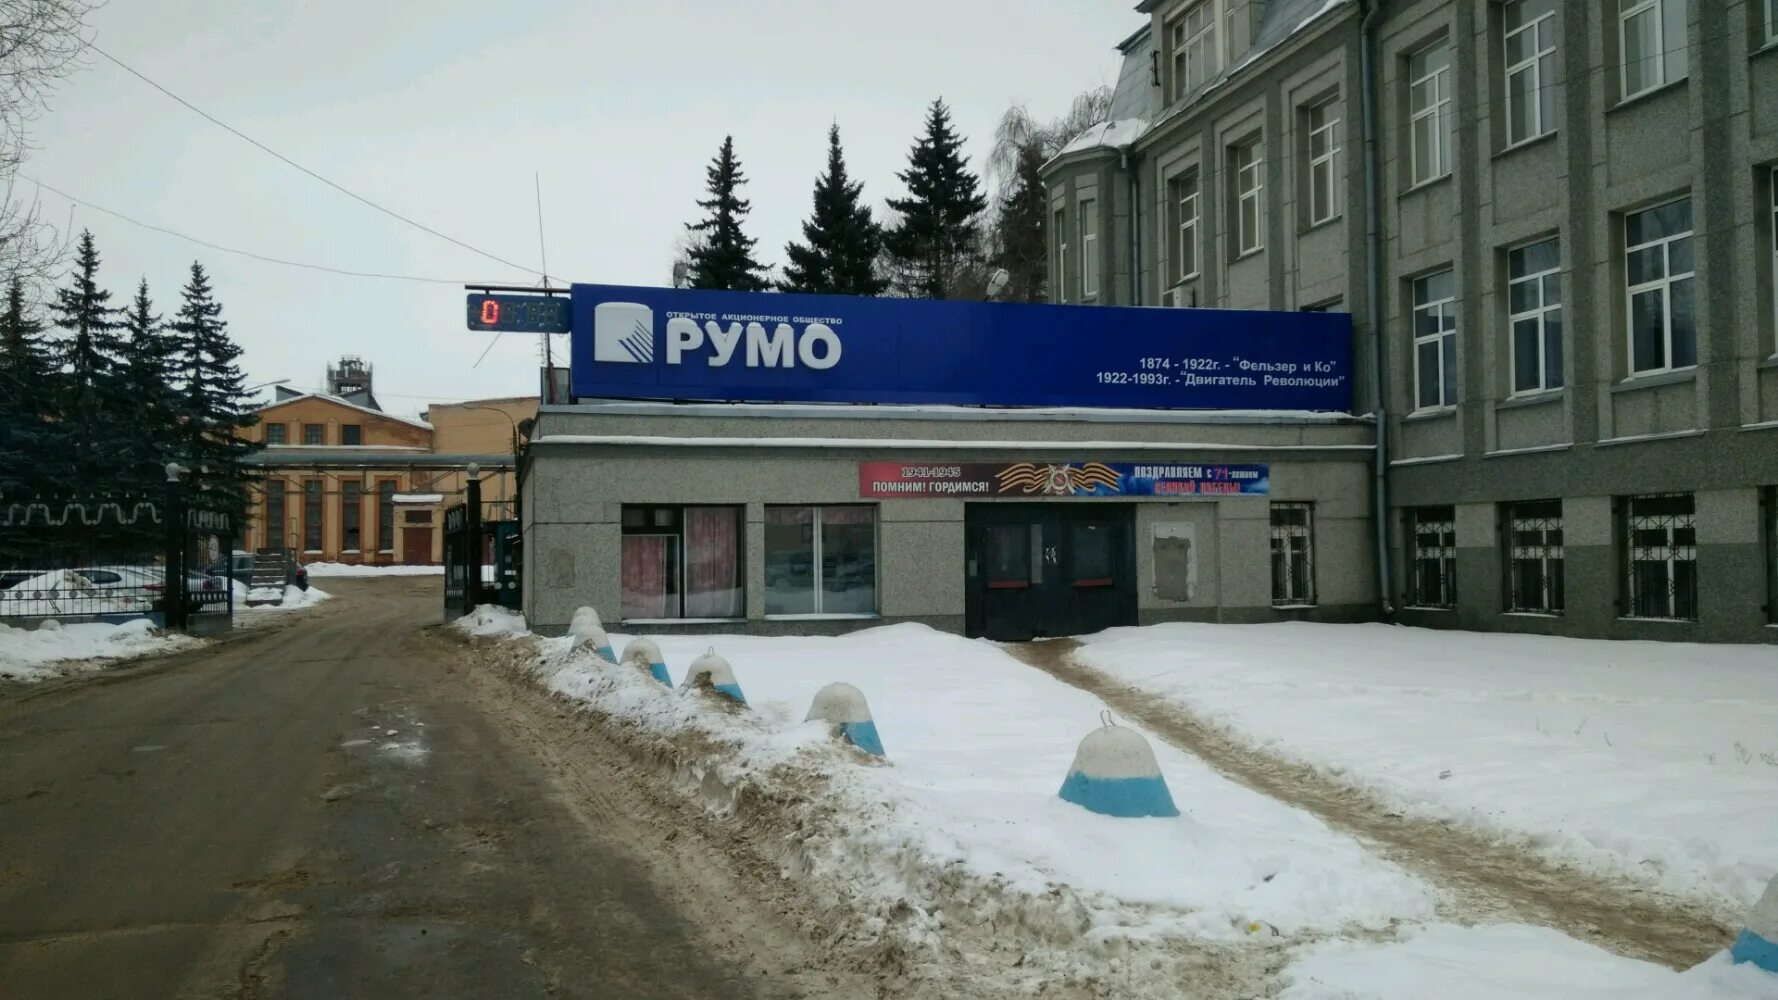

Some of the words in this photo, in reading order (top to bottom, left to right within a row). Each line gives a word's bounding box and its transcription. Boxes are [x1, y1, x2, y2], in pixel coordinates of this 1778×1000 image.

[481, 300, 498, 324] 0
[666, 311, 717, 320] ОТКРЫТОЕ
[722, 313, 789, 323] АКЦИОНЕРНОЕ
[793, 316, 843, 325] ОБЩЕСТВО
[666, 318, 842, 369] РУМО
[1139, 358, 1171, 370] 1874
[1183, 358, 1221, 370] 1922г.
[1303, 363, 1311, 372] и
[1096, 371, 1172, 385] 1922-1993г.
[901, 467, 961, 477] 1941-1945
[1134, 465, 1203, 479] ПОЗДРАВЛЯЕМ
[873, 481, 926, 492] ПОМНИМ!
[929, 481, 989, 494] ГОРДИМСЯ!
